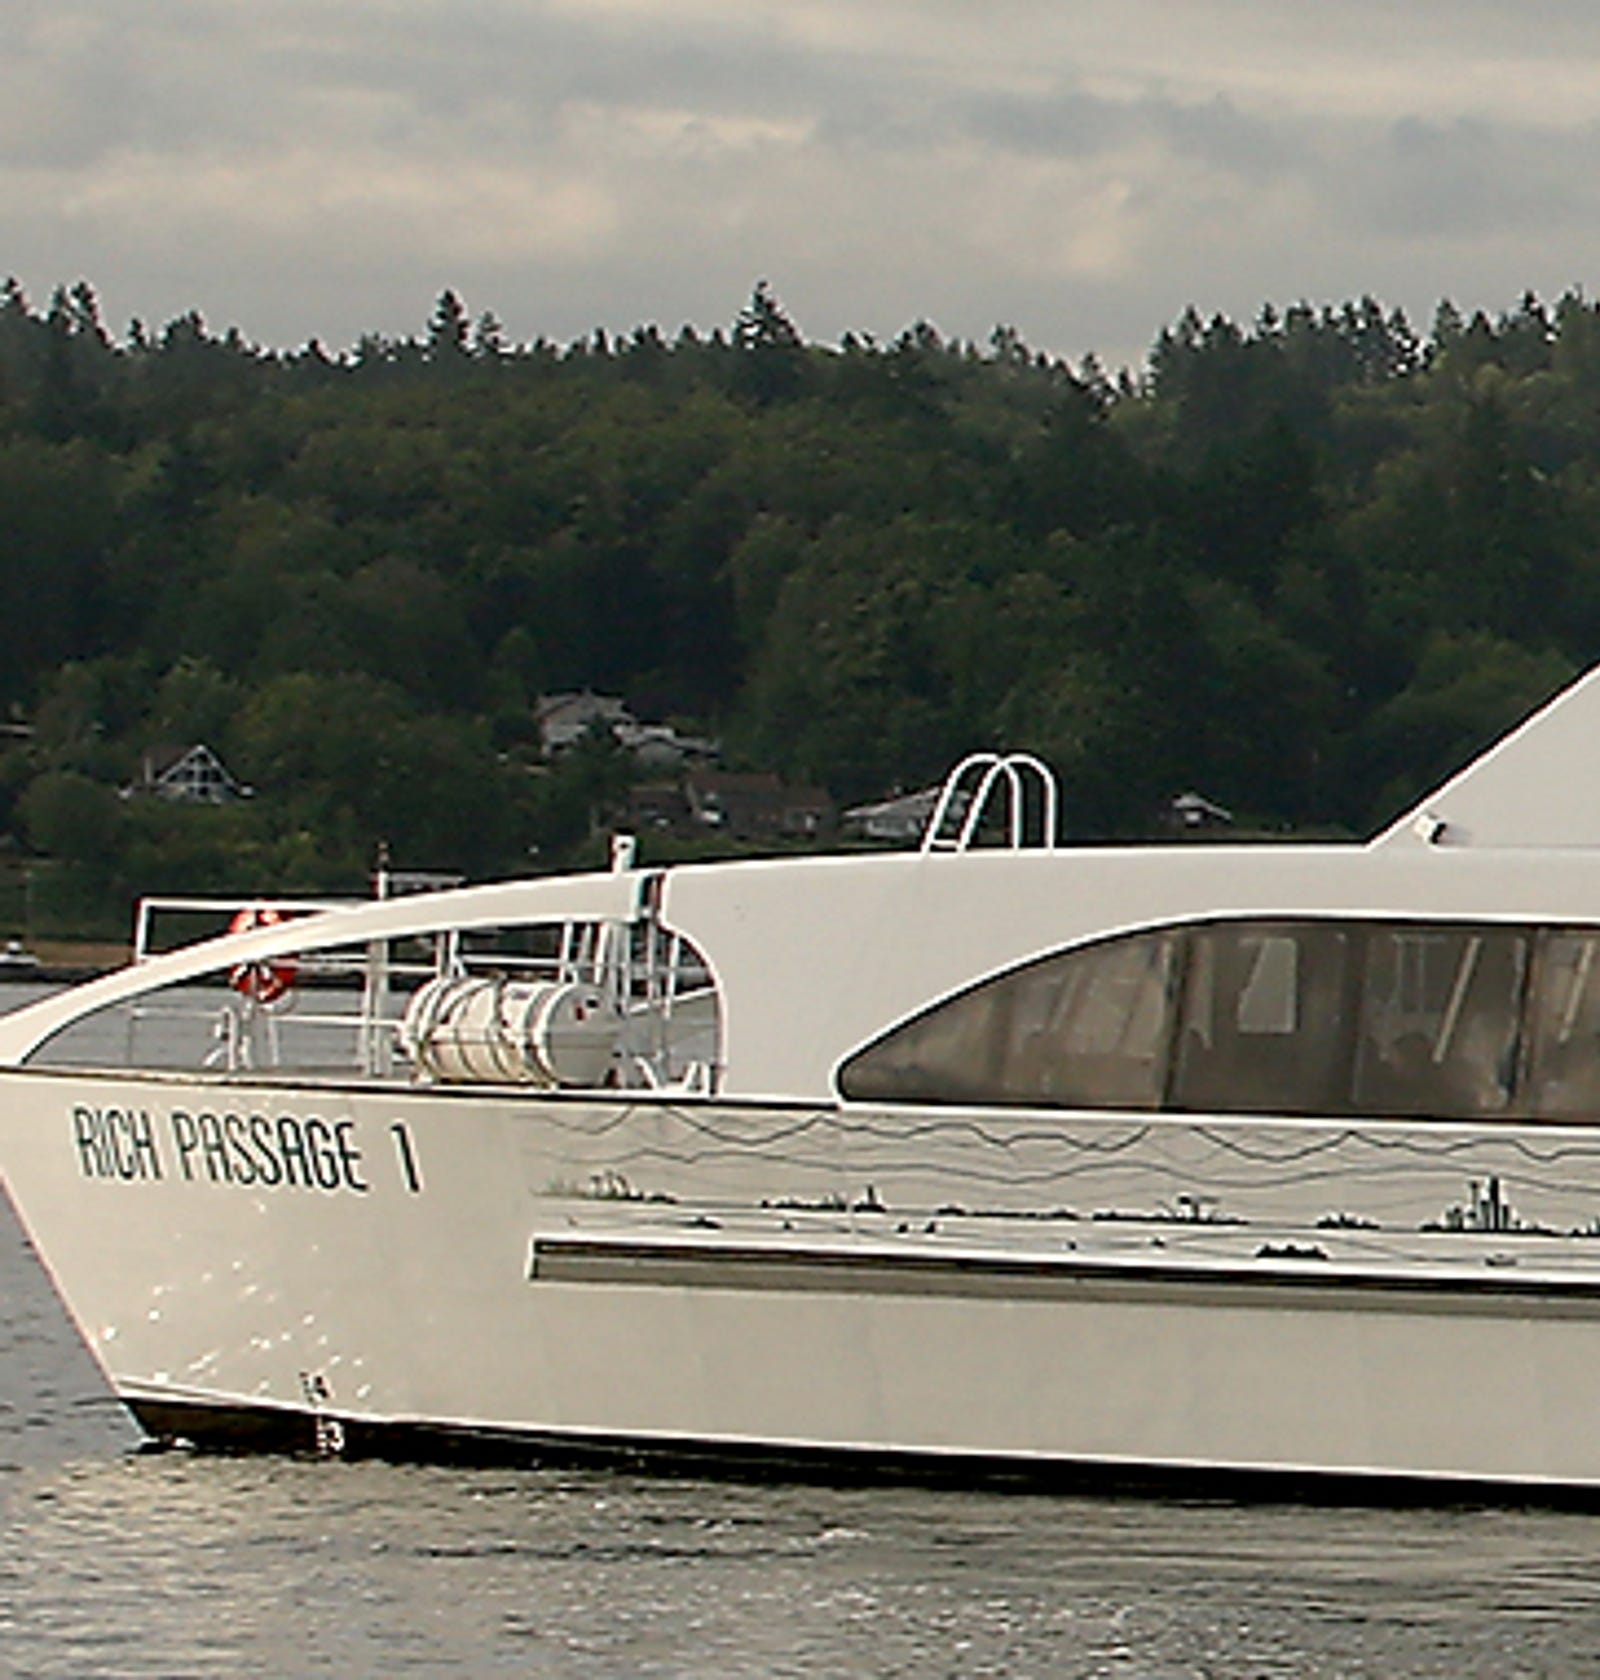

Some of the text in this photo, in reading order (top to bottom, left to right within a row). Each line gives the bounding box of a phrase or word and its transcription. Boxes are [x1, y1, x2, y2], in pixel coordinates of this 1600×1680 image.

[74, 1106, 420, 1192] RICH PASSAGE 1
